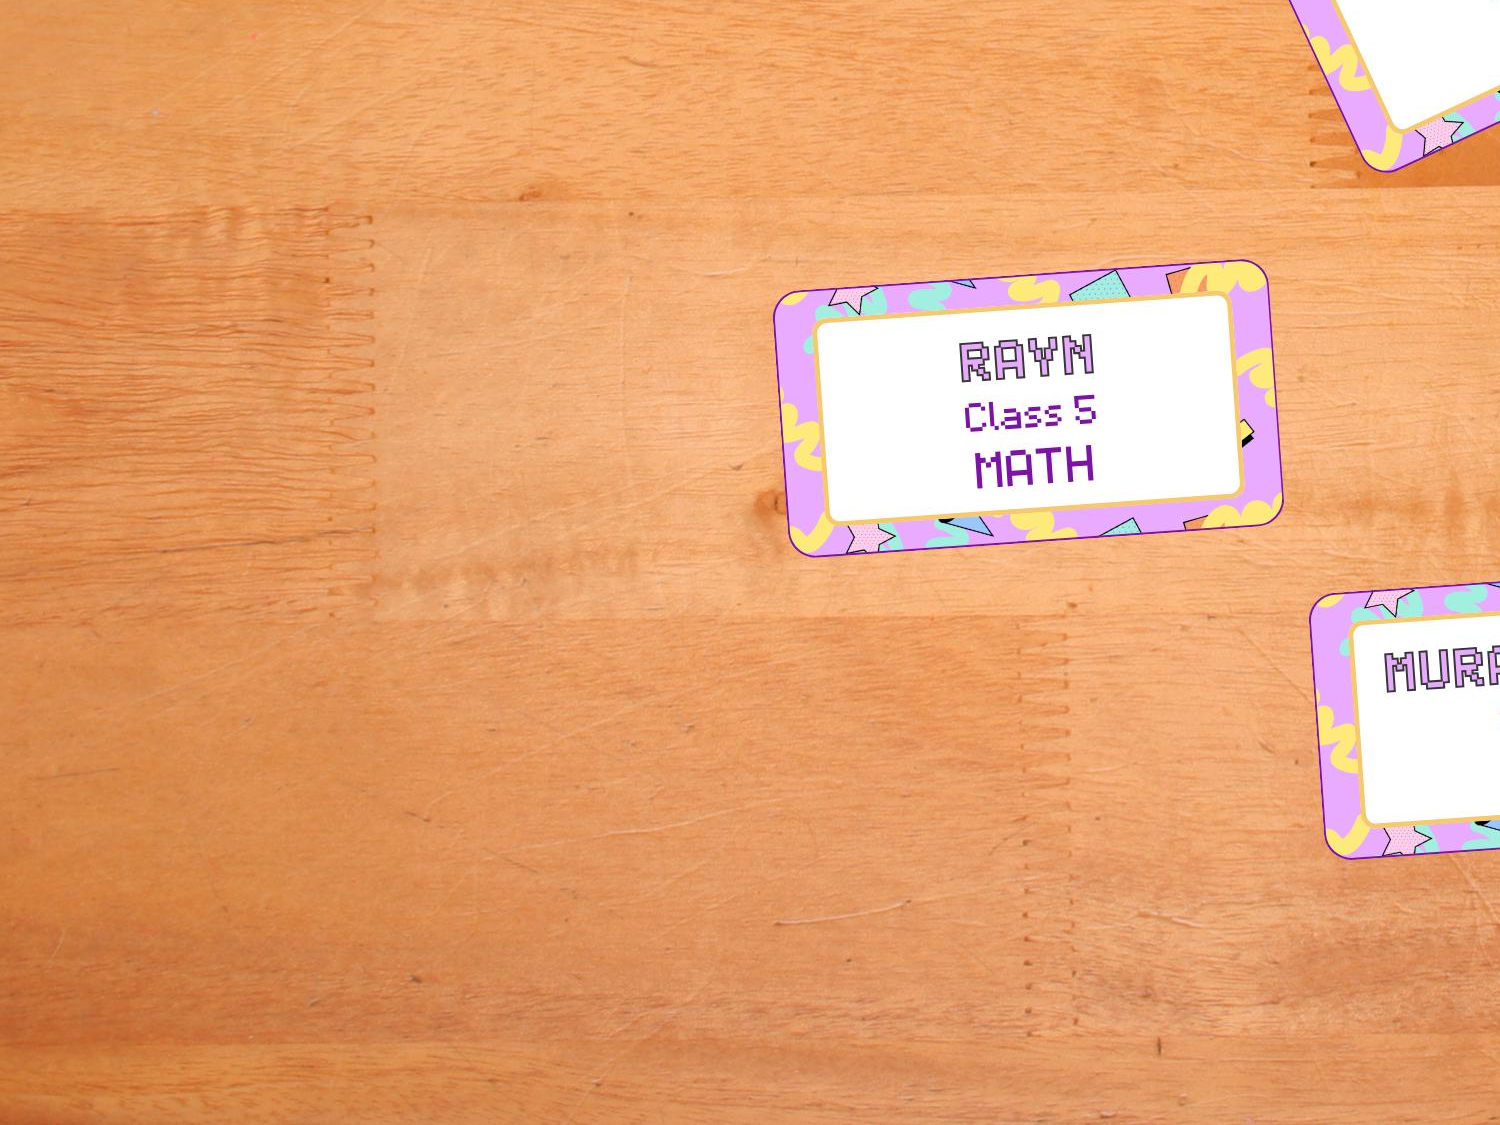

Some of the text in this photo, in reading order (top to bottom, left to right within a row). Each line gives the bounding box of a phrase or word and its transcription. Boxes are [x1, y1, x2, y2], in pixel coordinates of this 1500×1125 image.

[959, 334, 1095, 383] RAYN
[964, 394, 1097, 432] Class 5
[974, 444, 1094, 489] MATH
